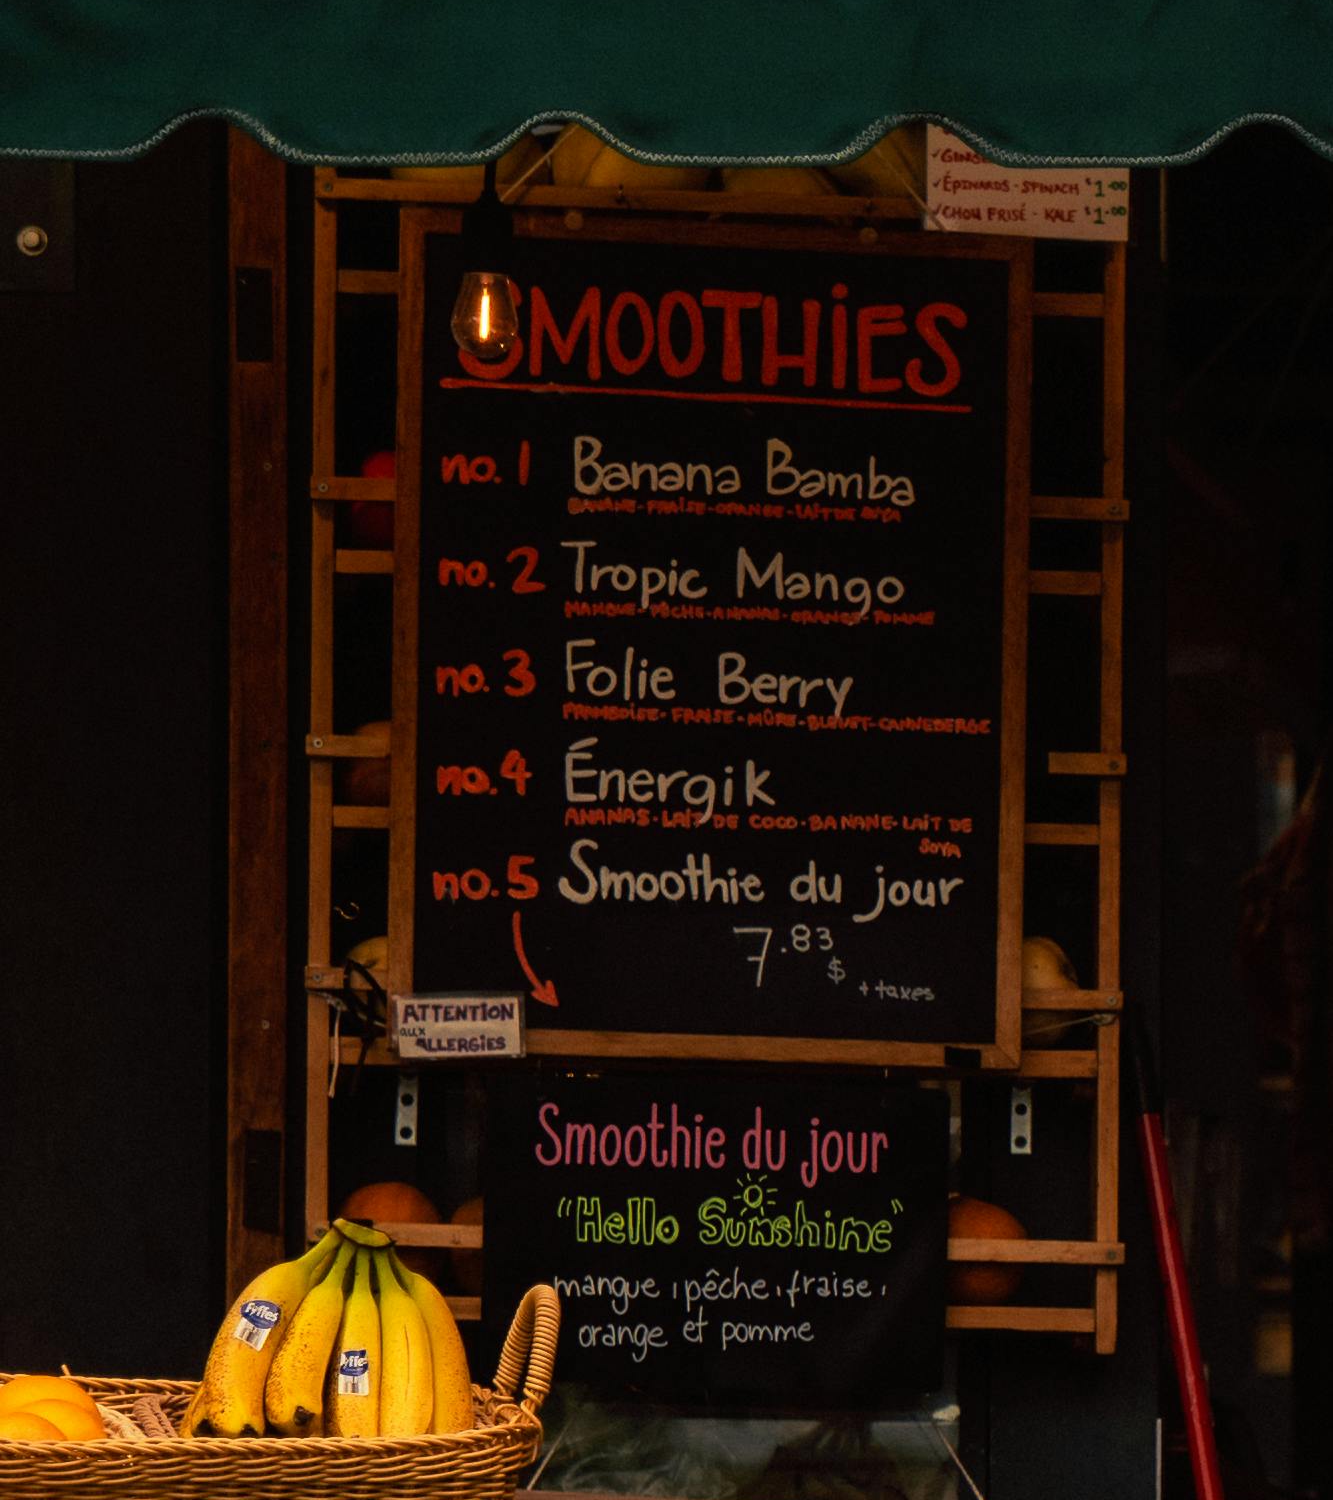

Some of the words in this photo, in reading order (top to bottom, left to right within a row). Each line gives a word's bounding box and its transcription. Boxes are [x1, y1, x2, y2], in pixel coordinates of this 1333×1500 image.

[1044, 208, 1078, 223] KALE
[572, 435, 743, 495] Banana
[766, 437, 916, 507] Bamba
[560, 540, 709, 611] Tropic
[736, 546, 905, 623] Mango
[563, 638, 677, 701] Folie
[717, 652, 855, 718] Berry
[563, 736, 778, 826] Énergik
[558, 838, 767, 906] Smoothie
[788, 859, 844, 905] du
[852, 863, 966, 924] jour
[874, 977, 936, 1004] taxes
[400, 1026, 426, 1037] aux
[534, 1102, 726, 1170] Smoothie
[742, 1106, 787, 1172] du
[800, 1116, 889, 1189] jour
[578, 1323, 669, 1362] orange
[682, 1305, 709, 1345] et
[720, 1316, 815, 1350] pomme
